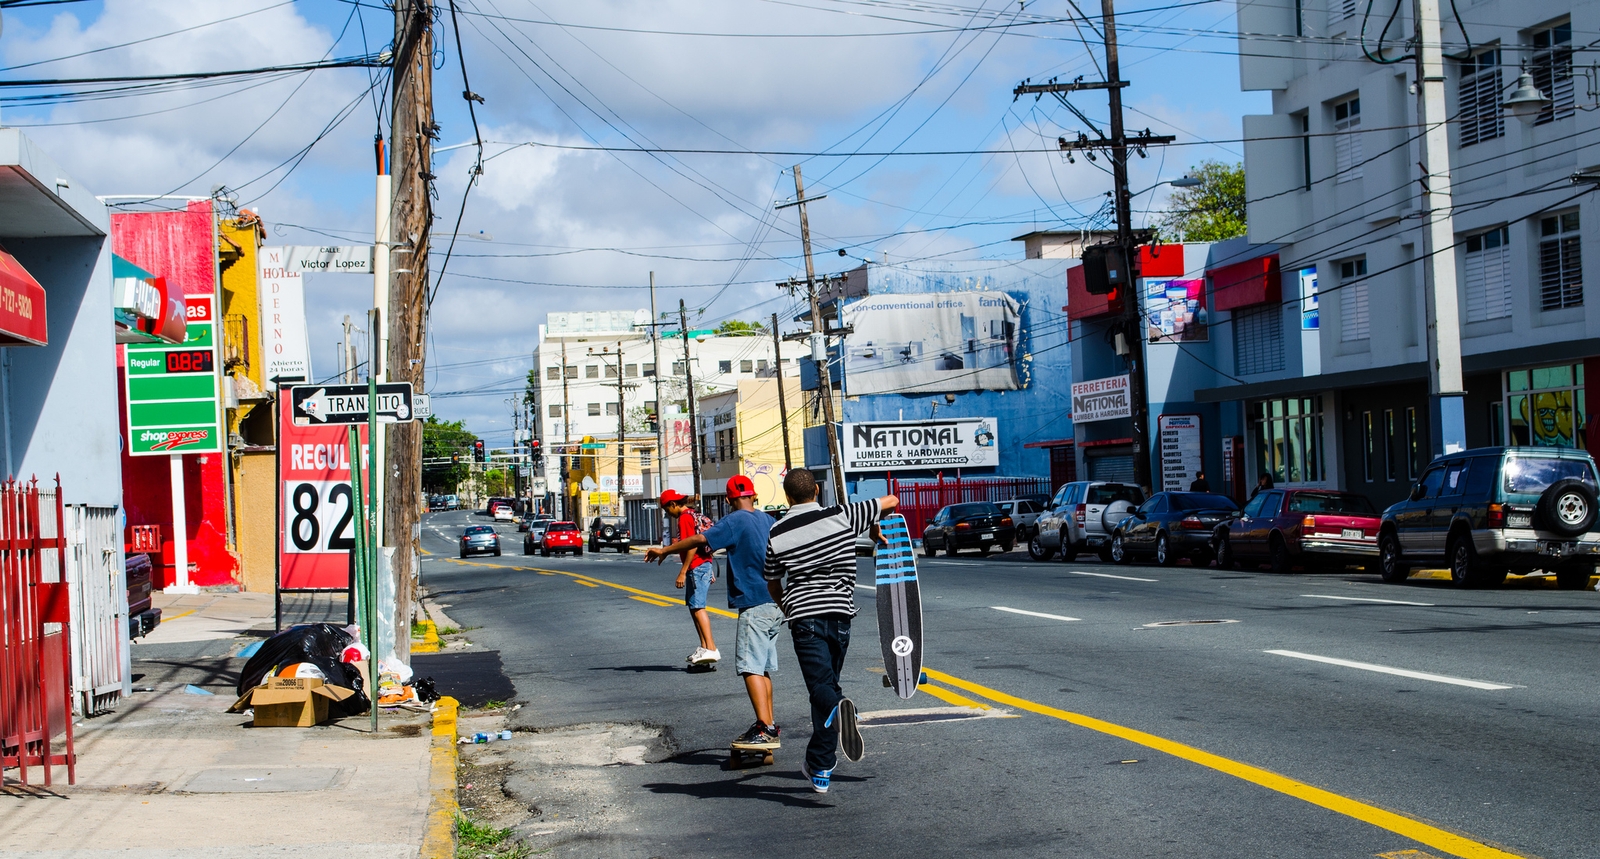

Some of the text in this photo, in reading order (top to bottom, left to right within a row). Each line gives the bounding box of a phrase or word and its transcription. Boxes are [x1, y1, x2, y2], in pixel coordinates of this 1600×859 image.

[301, 260, 365, 270] Victor Lopez
[853, 300, 966, 312] on-conventional office.
[130, 358, 161, 368] Regular
[1073, 378, 1127, 394] FERRETERIA
[327, 396, 399, 411] TRANITO
[1073, 390, 1128, 413] NATIONAL
[1074, 412, 1094, 421] LUMBER
[1100, 408, 1129, 417] HARDWARE
[853, 424, 963, 449] NATIONAL
[291, 444, 370, 470] REGULR
[856, 450, 892, 459] LUMBER
[907, 448, 958, 457] HARDWARE
[291, 483, 356, 551] 82
